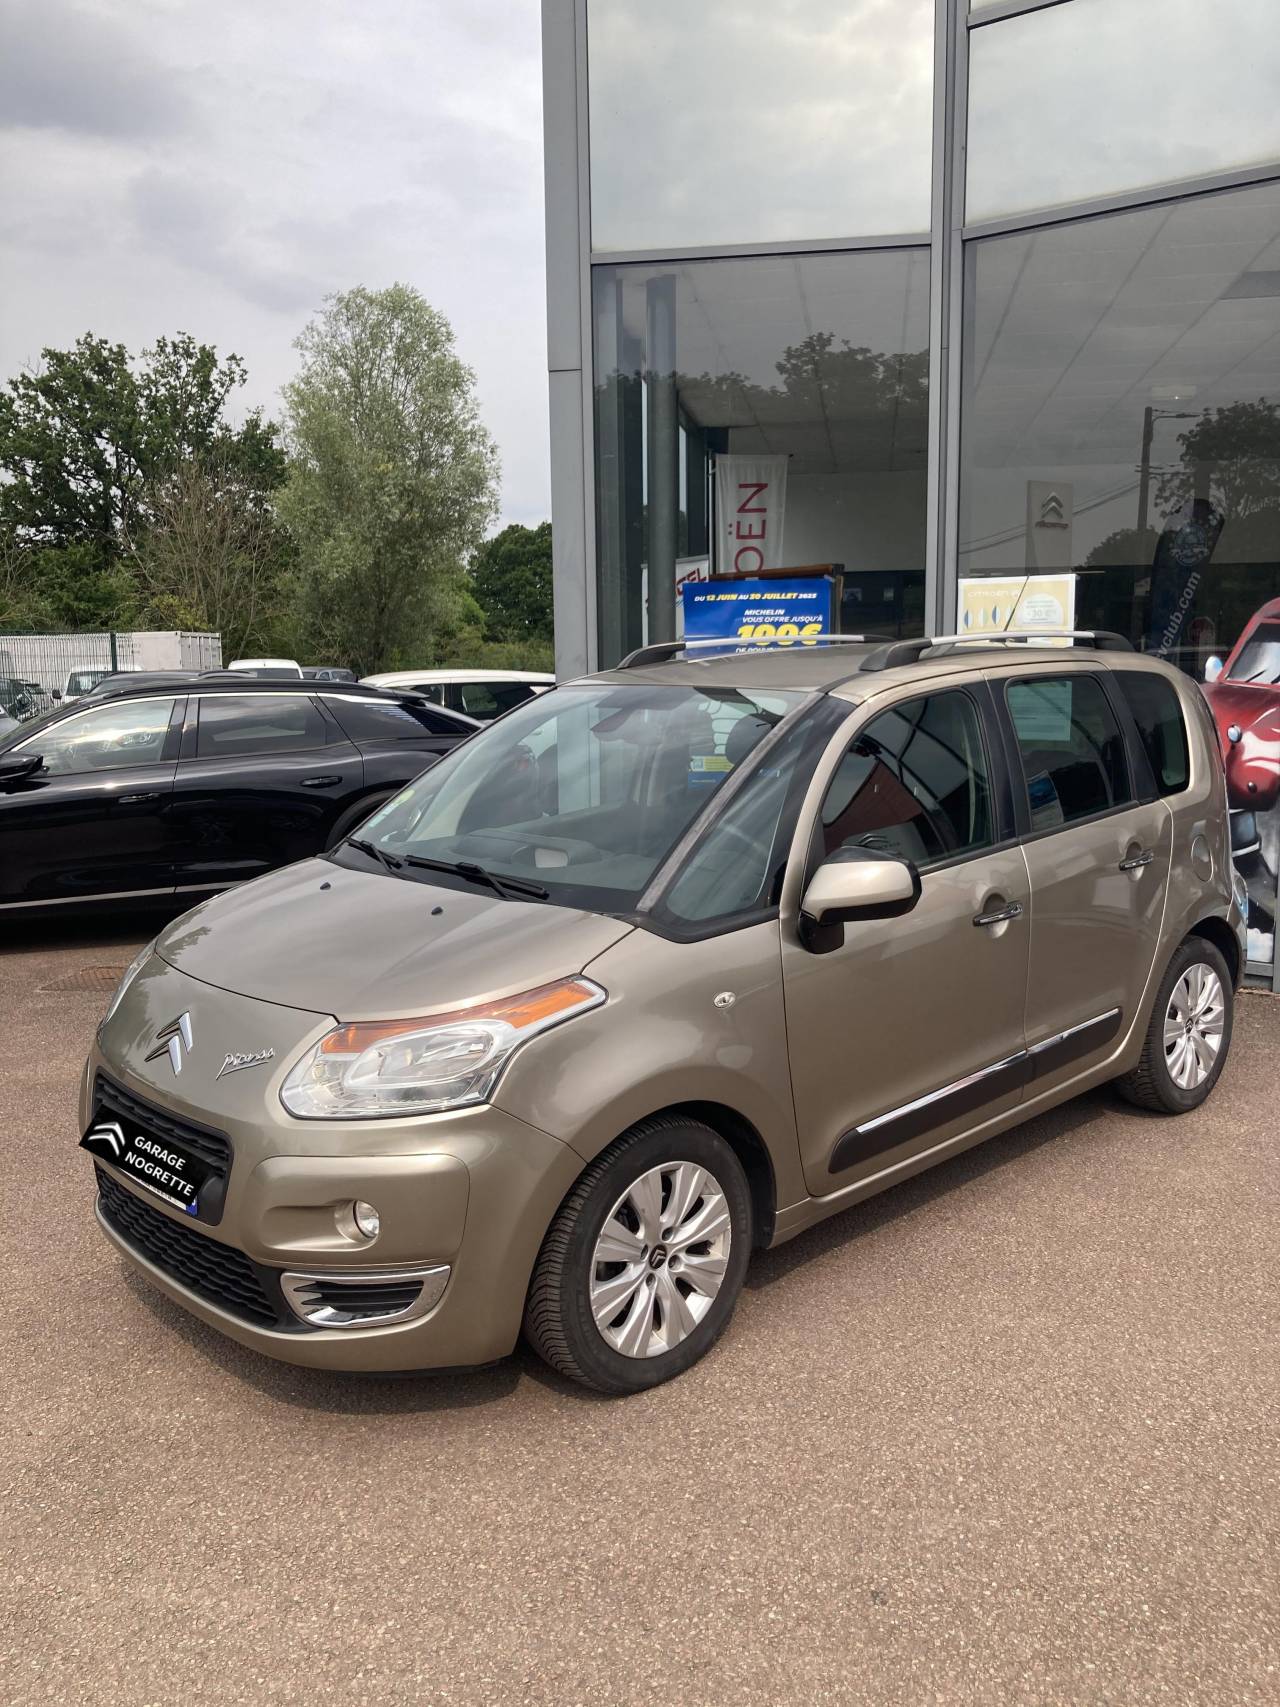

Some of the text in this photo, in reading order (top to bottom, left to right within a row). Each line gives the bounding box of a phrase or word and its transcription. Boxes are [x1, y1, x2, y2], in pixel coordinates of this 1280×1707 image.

[716, 593, 738, 601] JUIN
[762, 592, 798, 600] JUILLET
[790, 614, 823, 624] JUSQU'À
[737, 623, 823, 646] 100€
